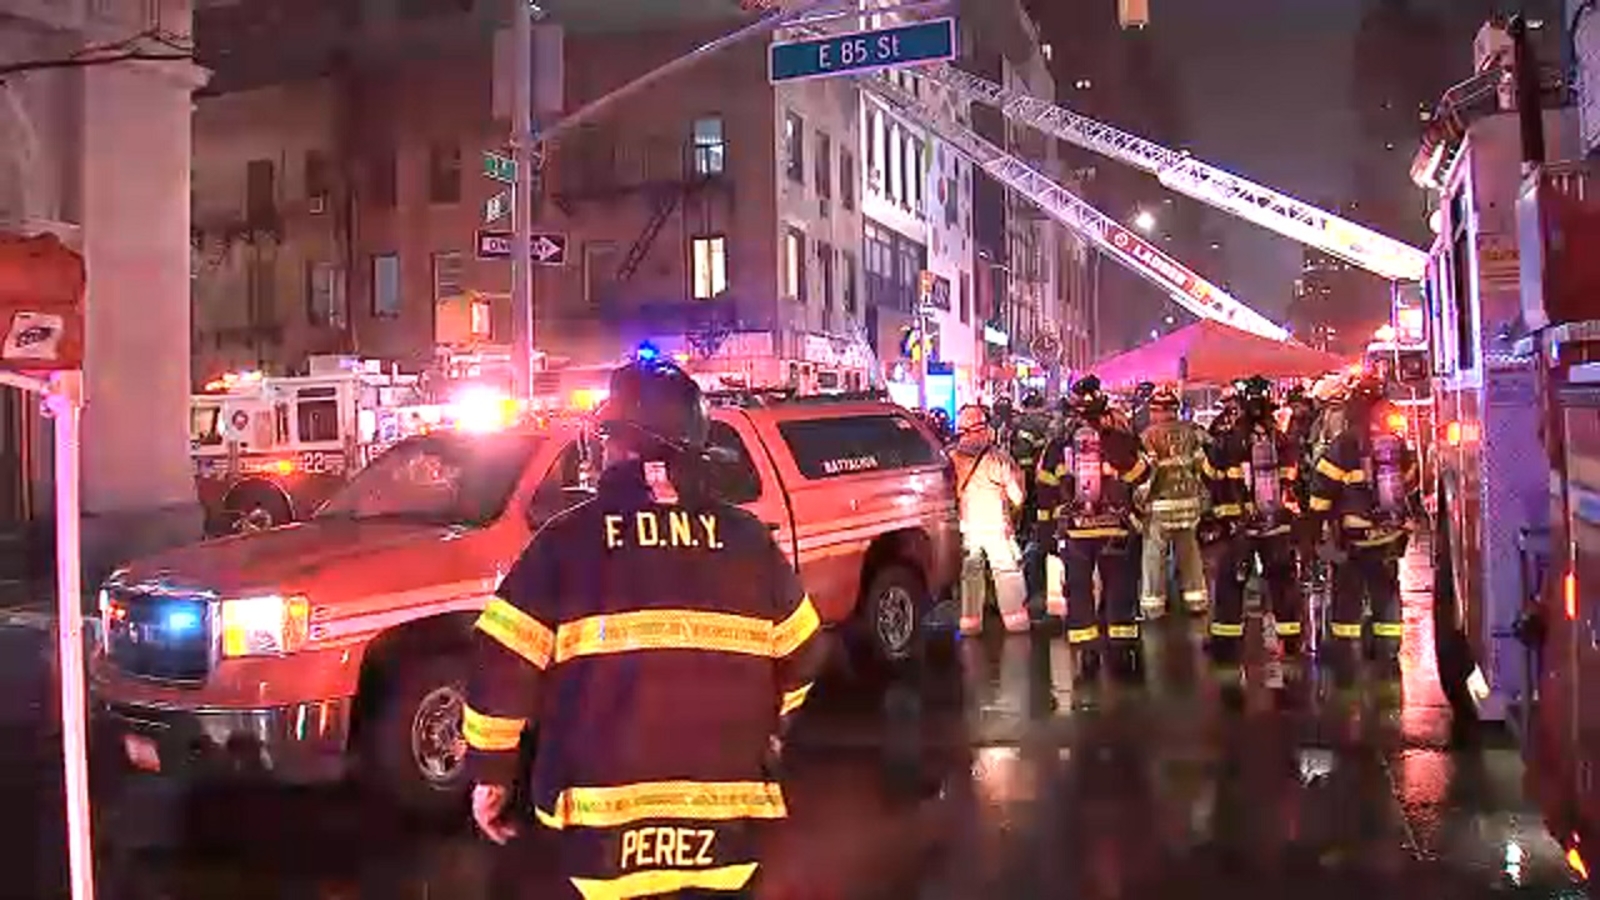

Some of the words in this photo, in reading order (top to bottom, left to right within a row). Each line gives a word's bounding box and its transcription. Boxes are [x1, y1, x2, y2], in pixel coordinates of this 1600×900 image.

[818, 45, 831, 69] E
[841, 39, 867, 65] 85
[876, 34, 900, 60] St
[1133, 244, 1187, 287] LADDER
[304, 452, 326, 474] 22
[621, 827, 715, 868] PEREZ
